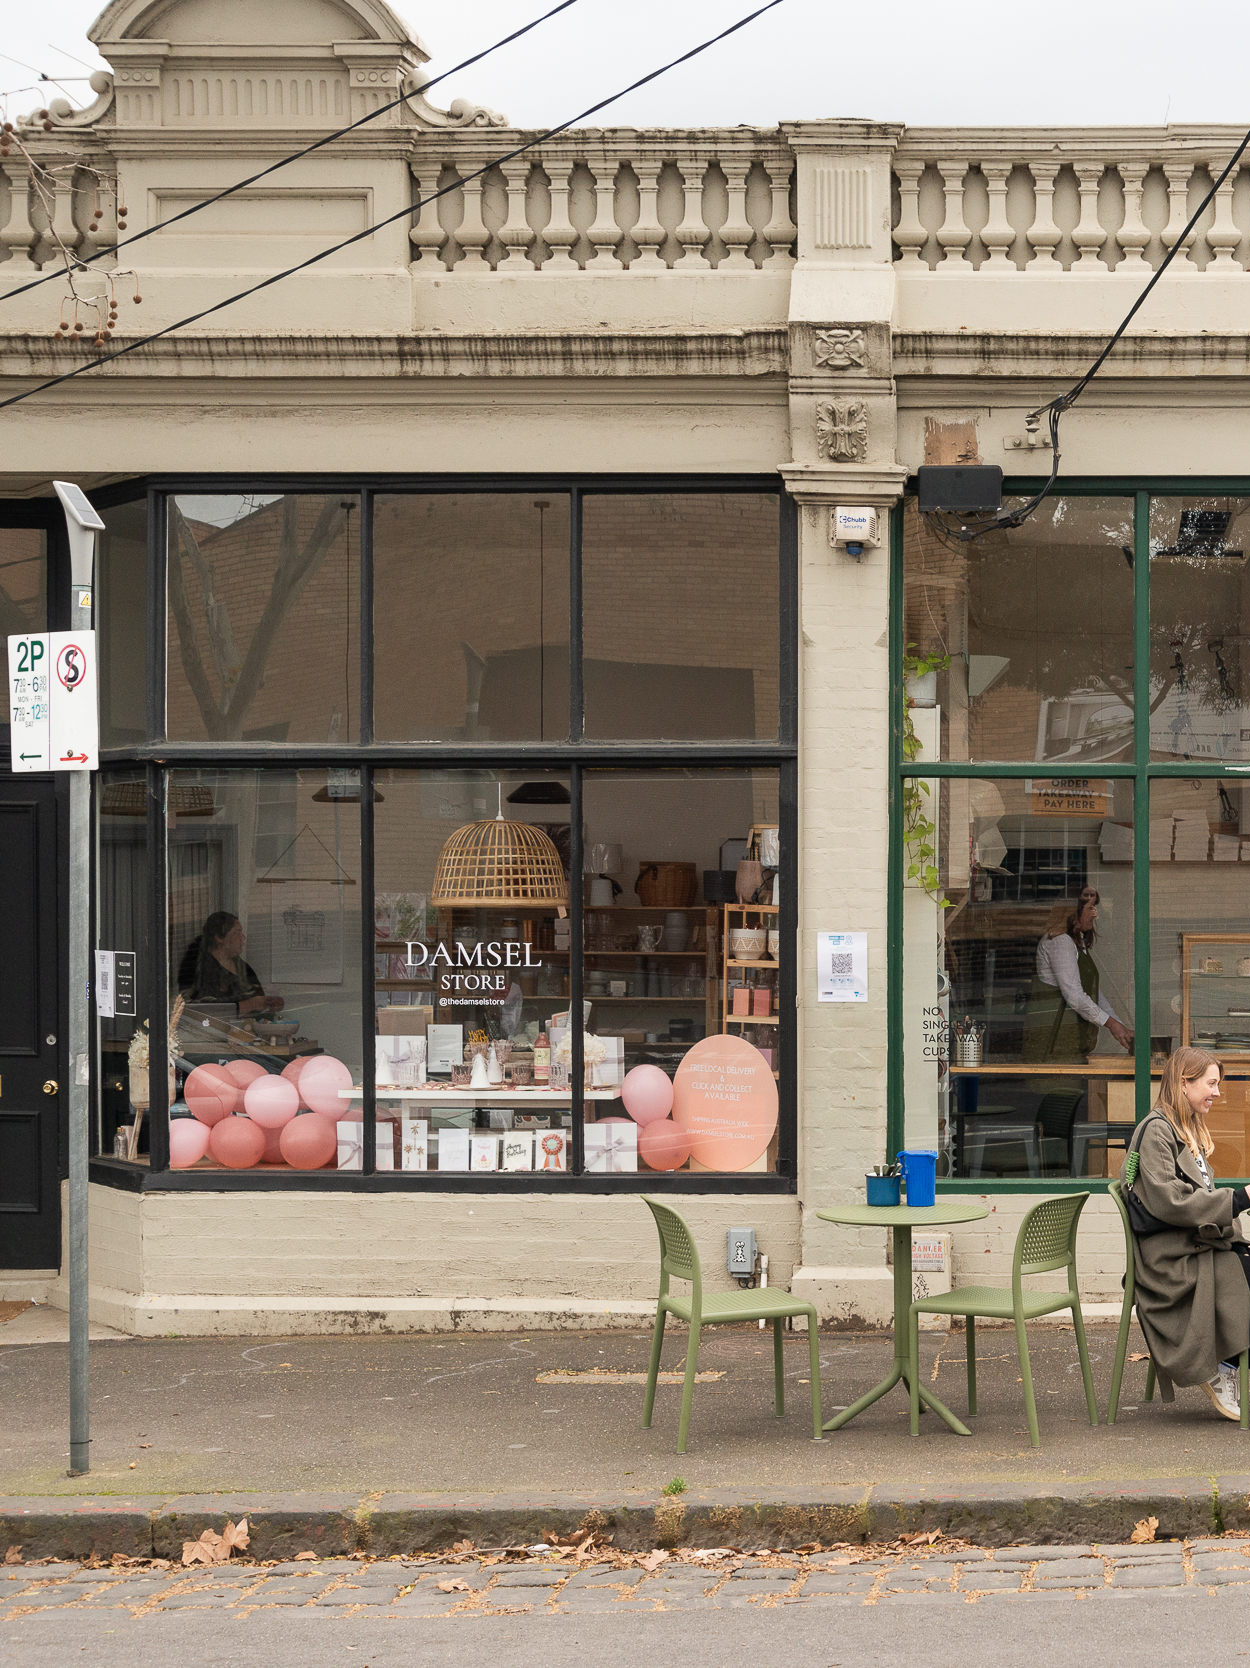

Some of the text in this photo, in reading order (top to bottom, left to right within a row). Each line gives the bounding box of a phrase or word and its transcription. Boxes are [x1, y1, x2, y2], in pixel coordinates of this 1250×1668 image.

[17, 640, 44, 672] 2P
[1051, 779, 1089, 788] ORDER
[1037, 788, 1094, 798] TAKEAWAY
[1044, 800, 1095, 809] PAY HERE
[405, 941, 542, 967] DAMSEL
[441, 974, 506, 990] STORE
[439, 998, 505, 1006] @thedamselstore
[923, 1006, 940, 1016] NO
[923, 1034, 981, 1043] TAKEAWAY
[923, 1047, 951, 1056] CUPS
[690, 1064, 756, 1076] FREE LOCAL DELIVERY
[692, 1082, 752, 1093] CLICK AND COLLECT
[704, 1092, 740, 1101] AVAILABLE
